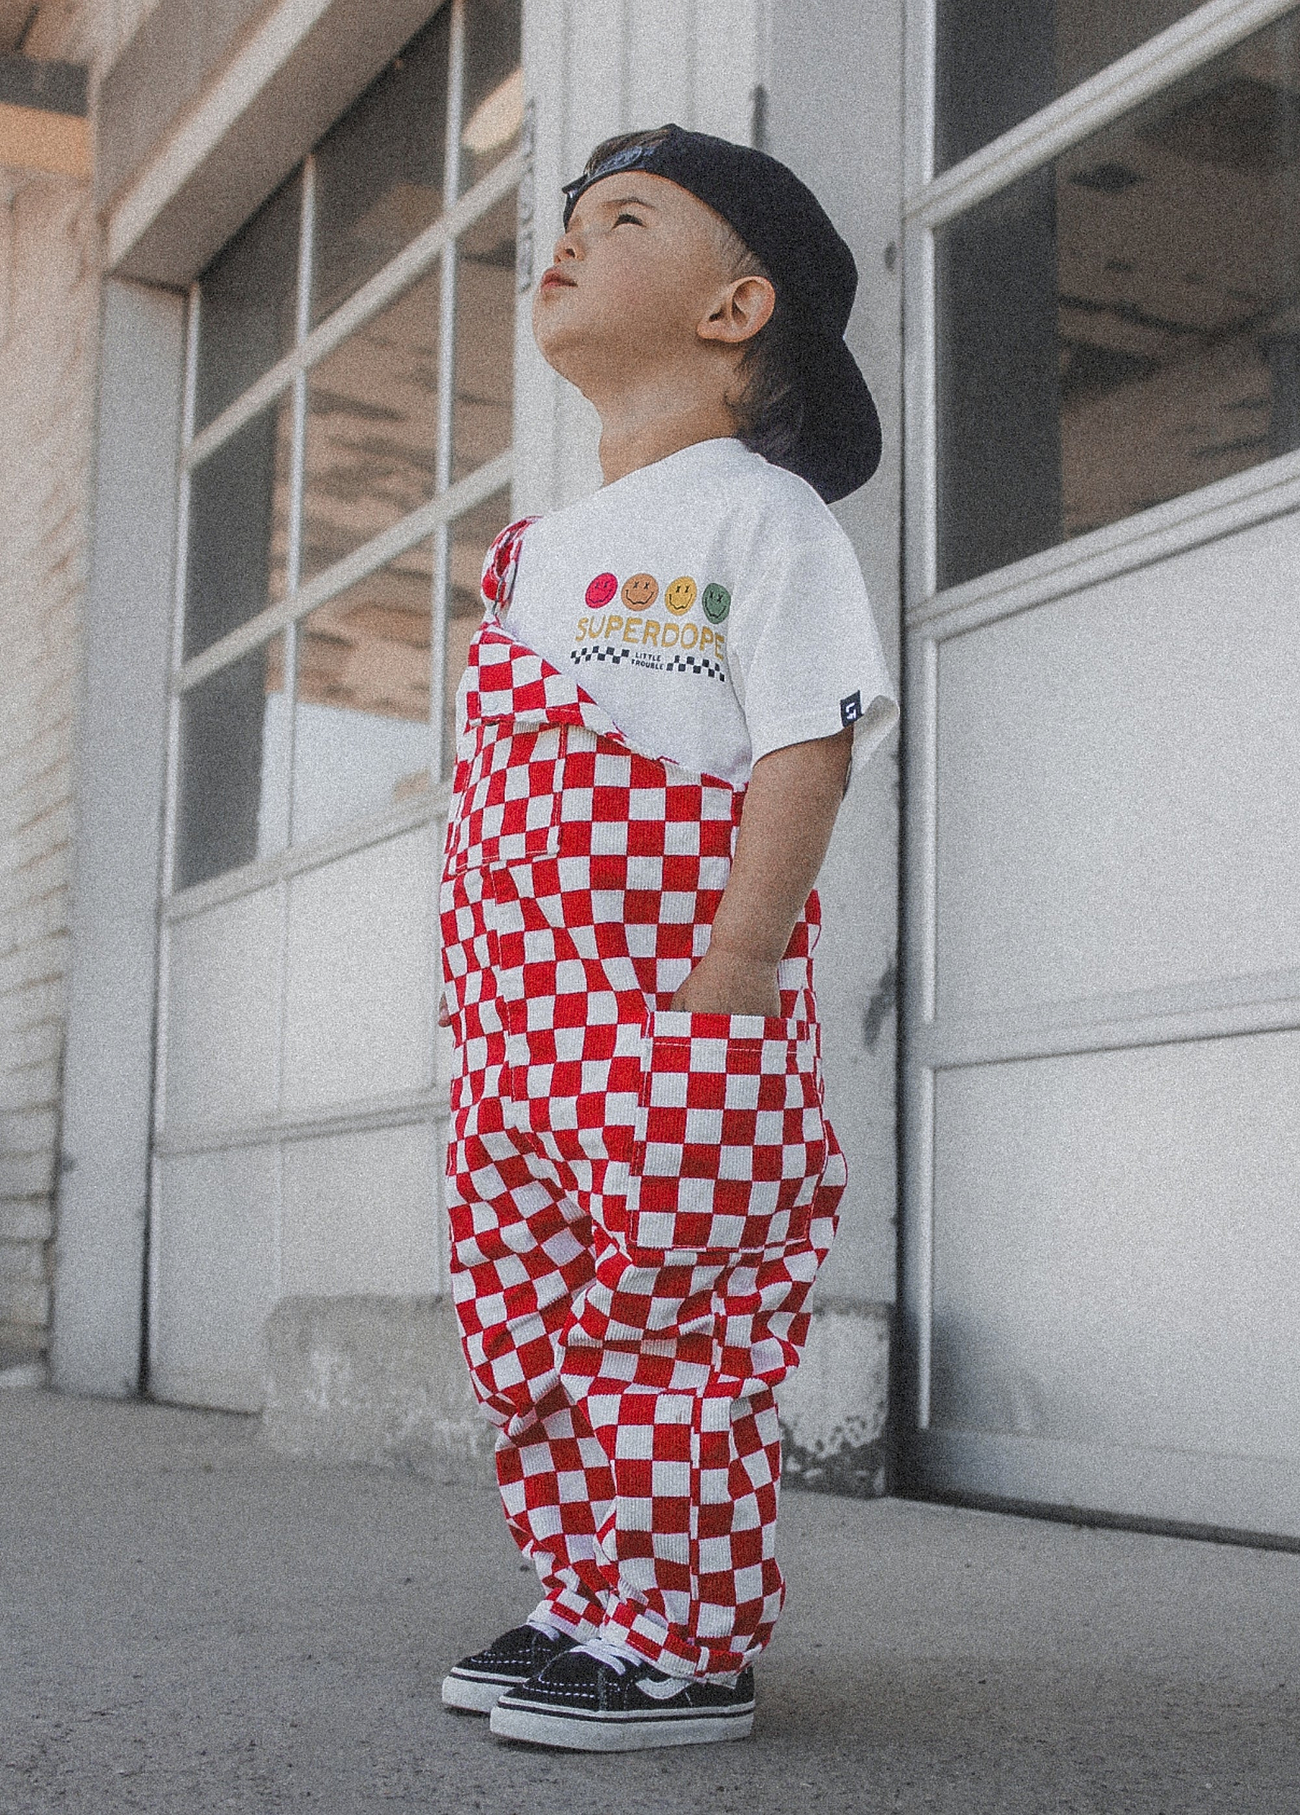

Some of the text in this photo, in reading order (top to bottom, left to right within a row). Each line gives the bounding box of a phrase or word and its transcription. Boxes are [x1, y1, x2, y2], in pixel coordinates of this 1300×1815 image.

[575, 614, 725, 661] SUPERDOPE
[635, 652, 661, 662] LITTLE
[631, 659, 664, 670] TROUBLE
